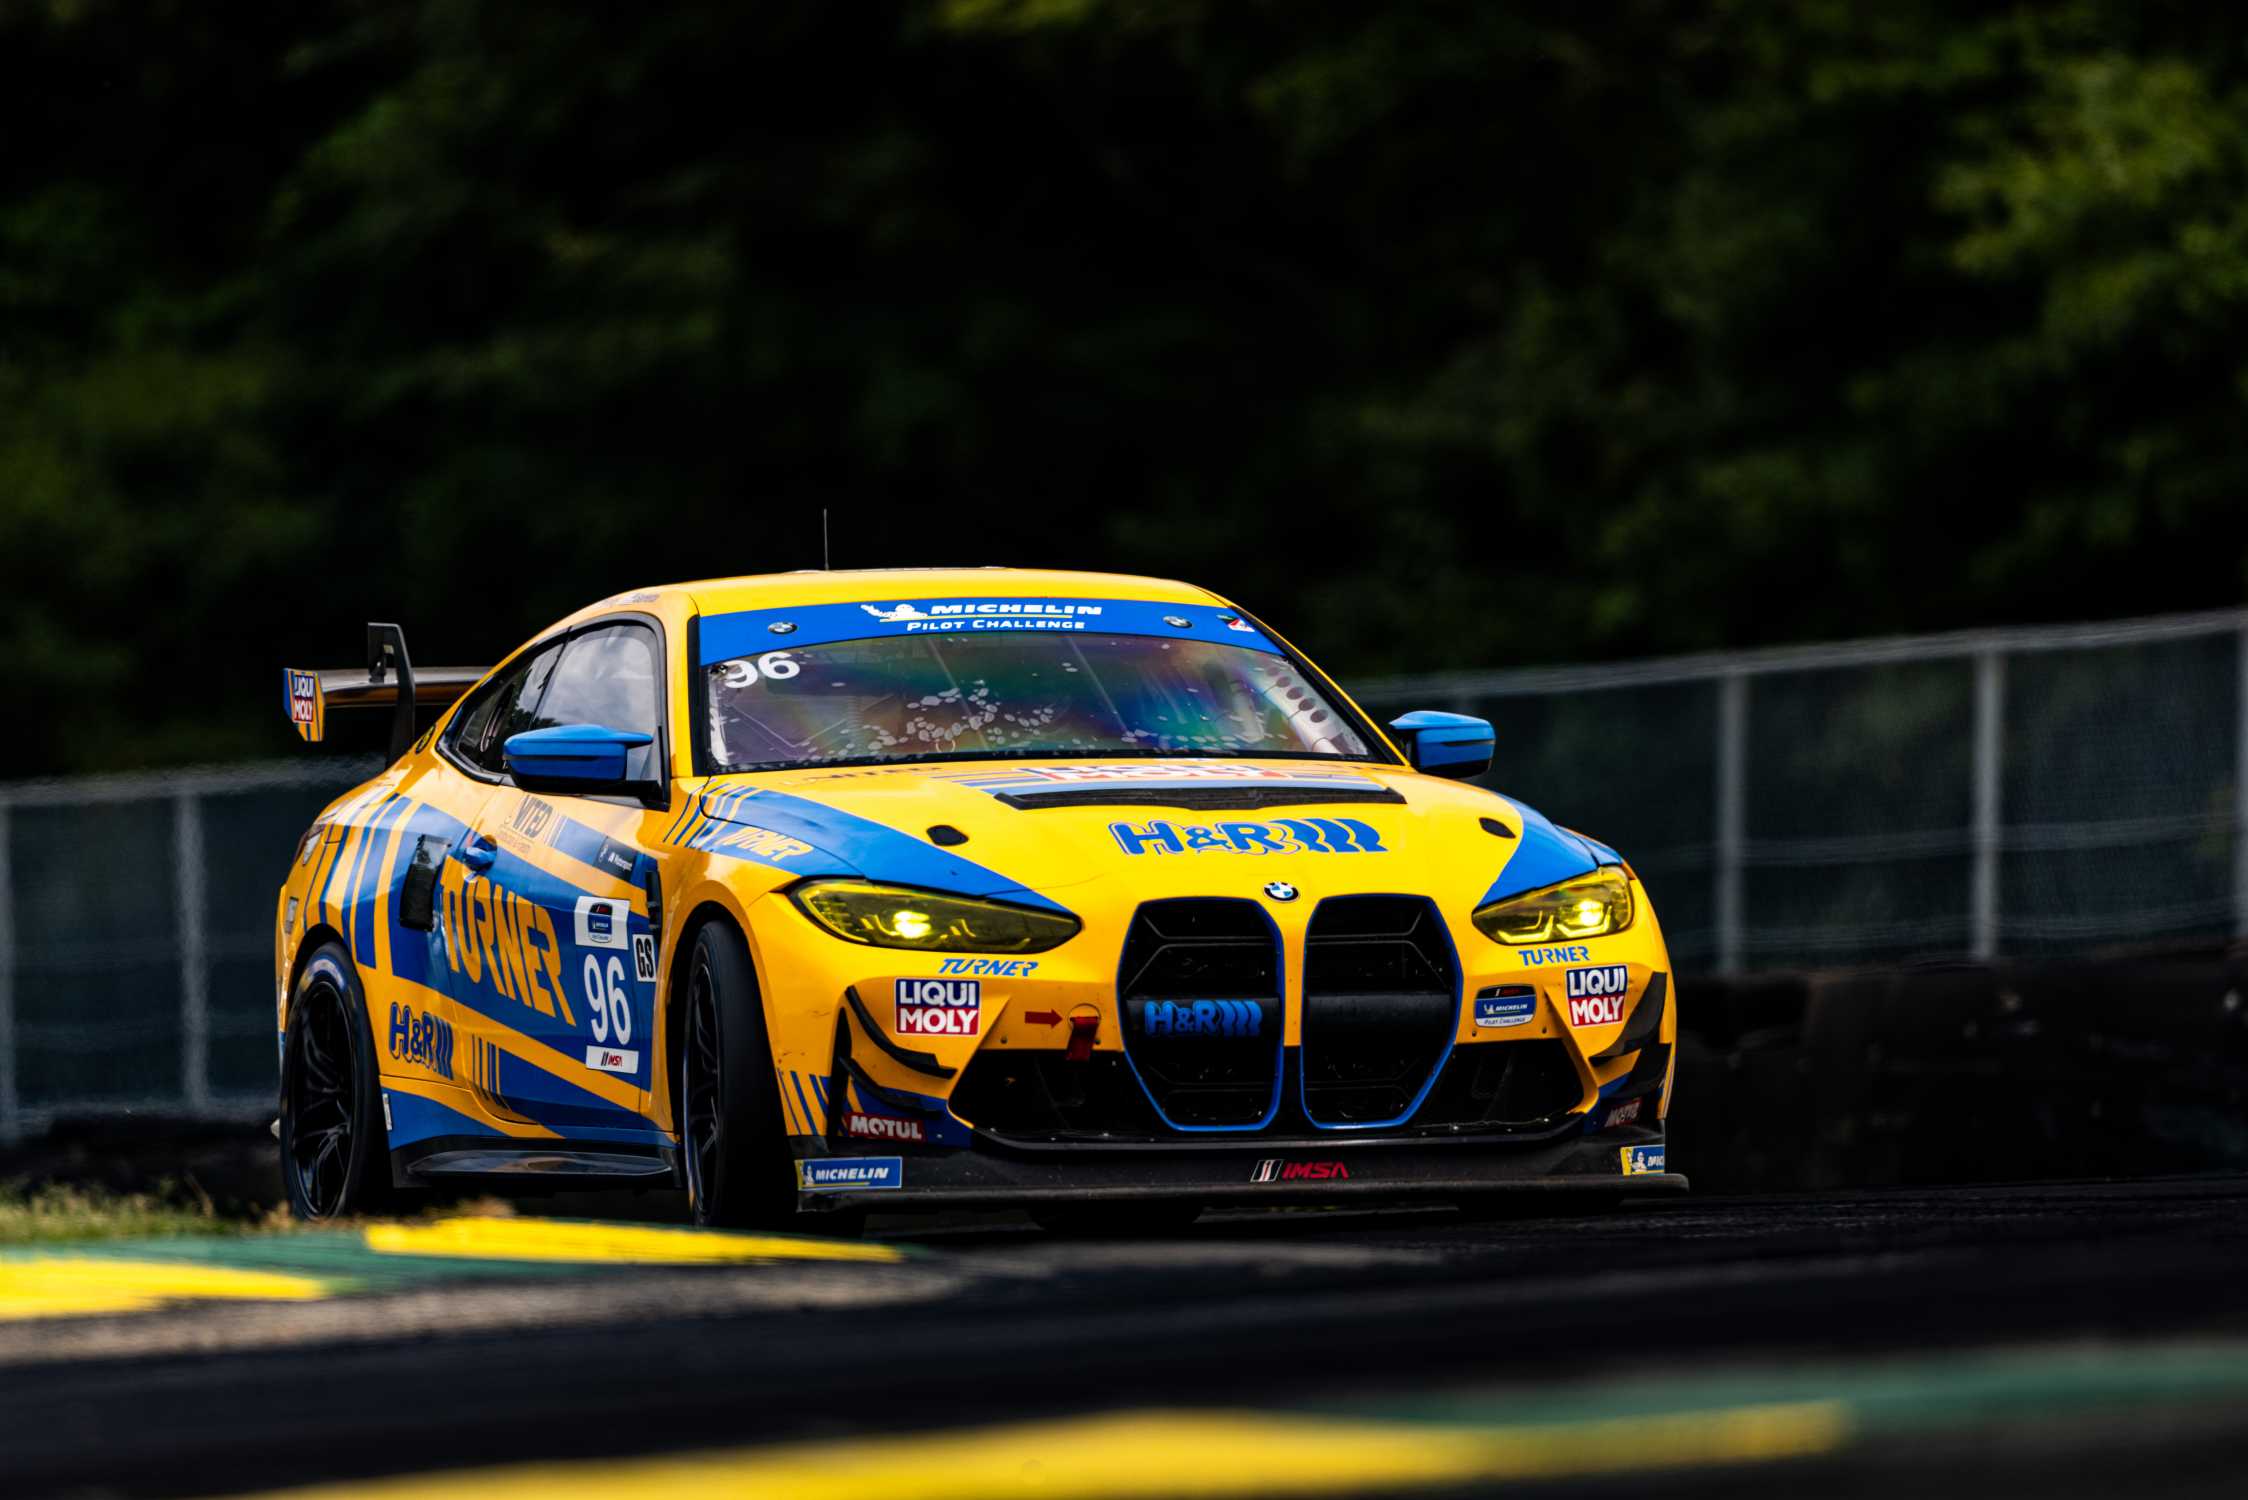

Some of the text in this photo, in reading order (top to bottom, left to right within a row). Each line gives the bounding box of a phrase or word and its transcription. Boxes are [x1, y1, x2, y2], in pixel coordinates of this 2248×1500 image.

[931, 603, 1102, 615] MICHELIN
[907, 619, 1085, 631] PILOT CHALLENGE
[720, 651, 800, 688] 96
[440, 880, 577, 1027] TURNER
[635, 937, 654, 979] GS
[939, 958, 1039, 976] TURNER
[1518, 946, 1591, 966] TURNER
[899, 980, 977, 1007] LIQUI
[1568, 967, 1626, 997] LIQUI
[584, 953, 632, 1045] 96
[1570, 995, 1625, 1025] MOLY
[899, 1007, 978, 1034] MOLY
[850, 1115, 923, 1140] MOTUL
[815, 1167, 889, 1181] MICHELIN
[1281, 1161, 1350, 1181] IMSA
